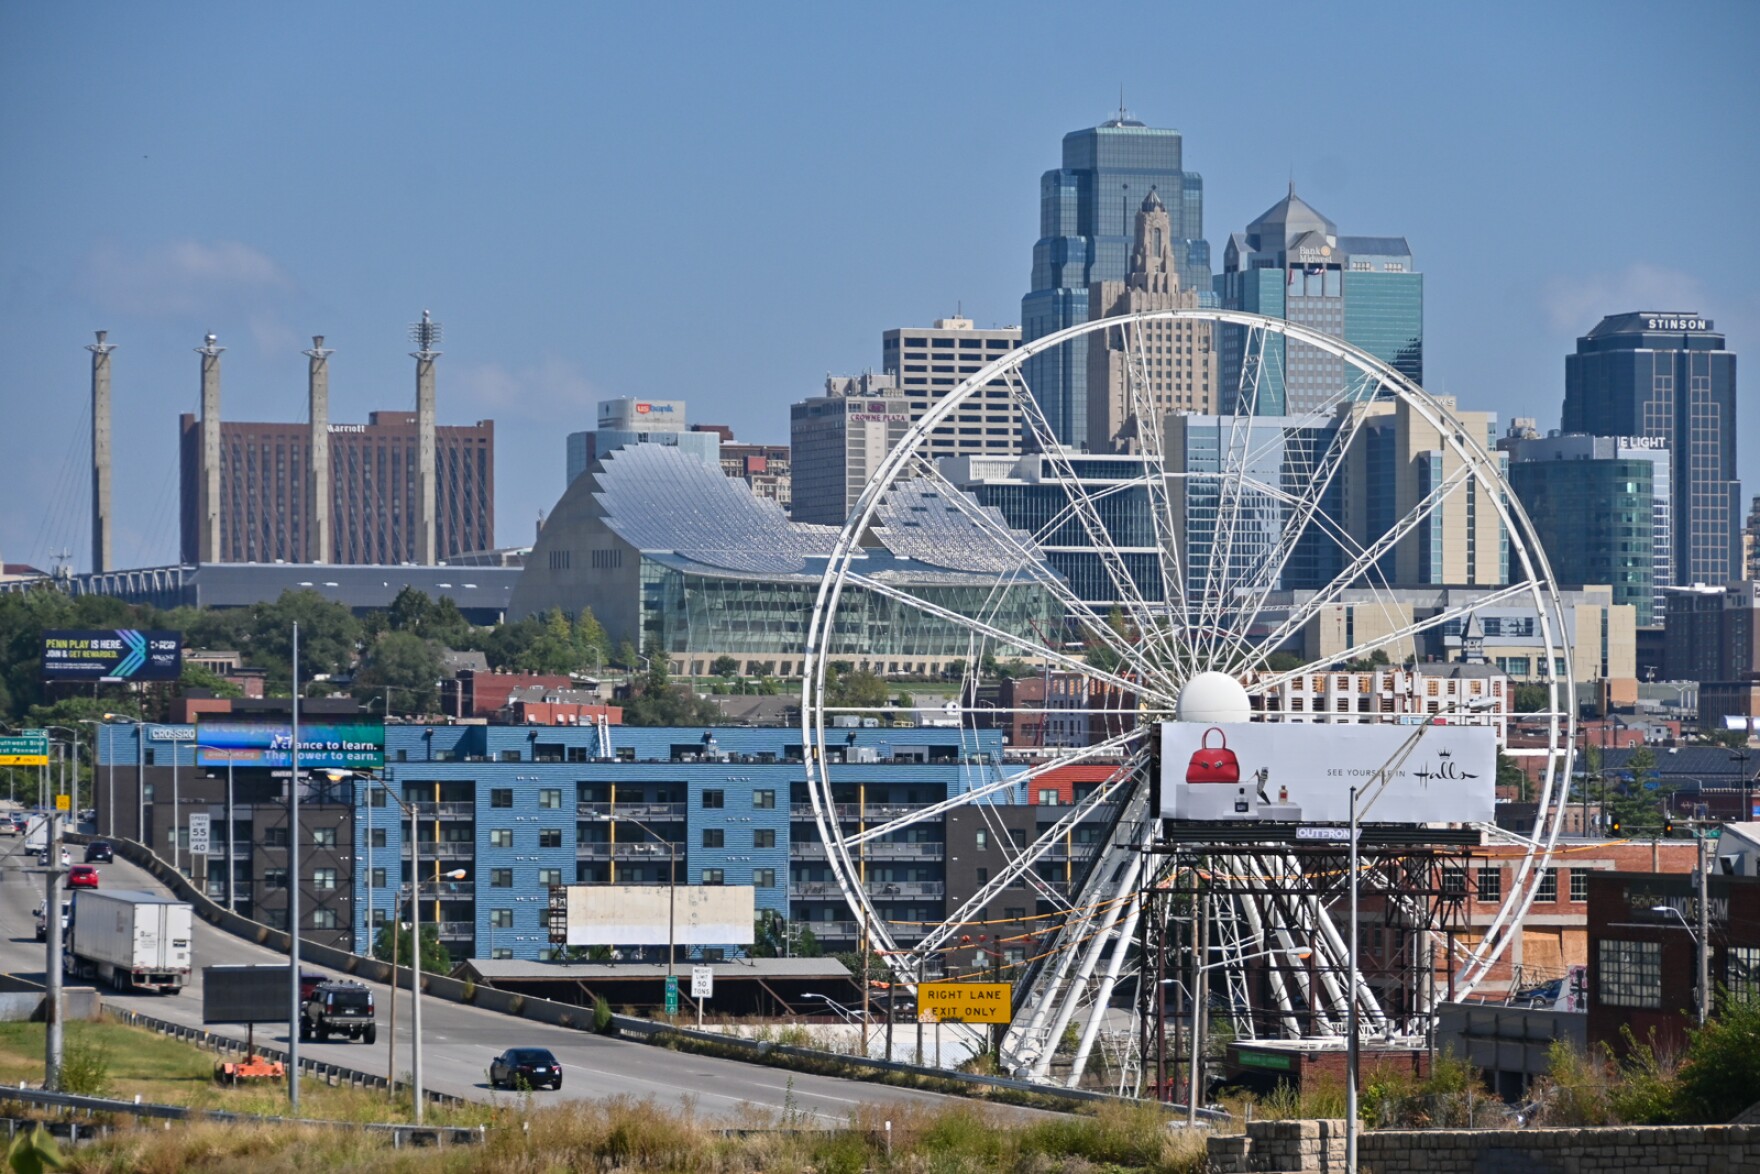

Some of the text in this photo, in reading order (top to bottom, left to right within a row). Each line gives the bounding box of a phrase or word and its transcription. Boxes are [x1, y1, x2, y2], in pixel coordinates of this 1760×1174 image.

[1649, 319, 1706, 330] STINSON
[850, 413, 906, 422] CROWNE PLAZA
[327, 424, 365, 433] Marriott
[1630, 436, 1666, 448] LIGHT
[46, 640, 123, 649] PENN PLAY IS HERE.
[46, 650, 60, 658] JOIN
[62, 650, 68, 658] &
[69, 650, 80, 658] GET
[270, 741, 278, 750] A
[326, 741, 339, 750] to
[342, 740, 377, 750] learn.
[265, 751, 286, 760] The
[331, 751, 343, 760] to
[346, 752, 377, 760] earn.
[1413, 761, 1479, 791] Halls
[192, 828, 207, 836] 55
[928, 990, 1001, 999] RIGHT LANE
[932, 1007, 957, 1015] EXIT
[965, 1007, 996, 1016] ONLY
